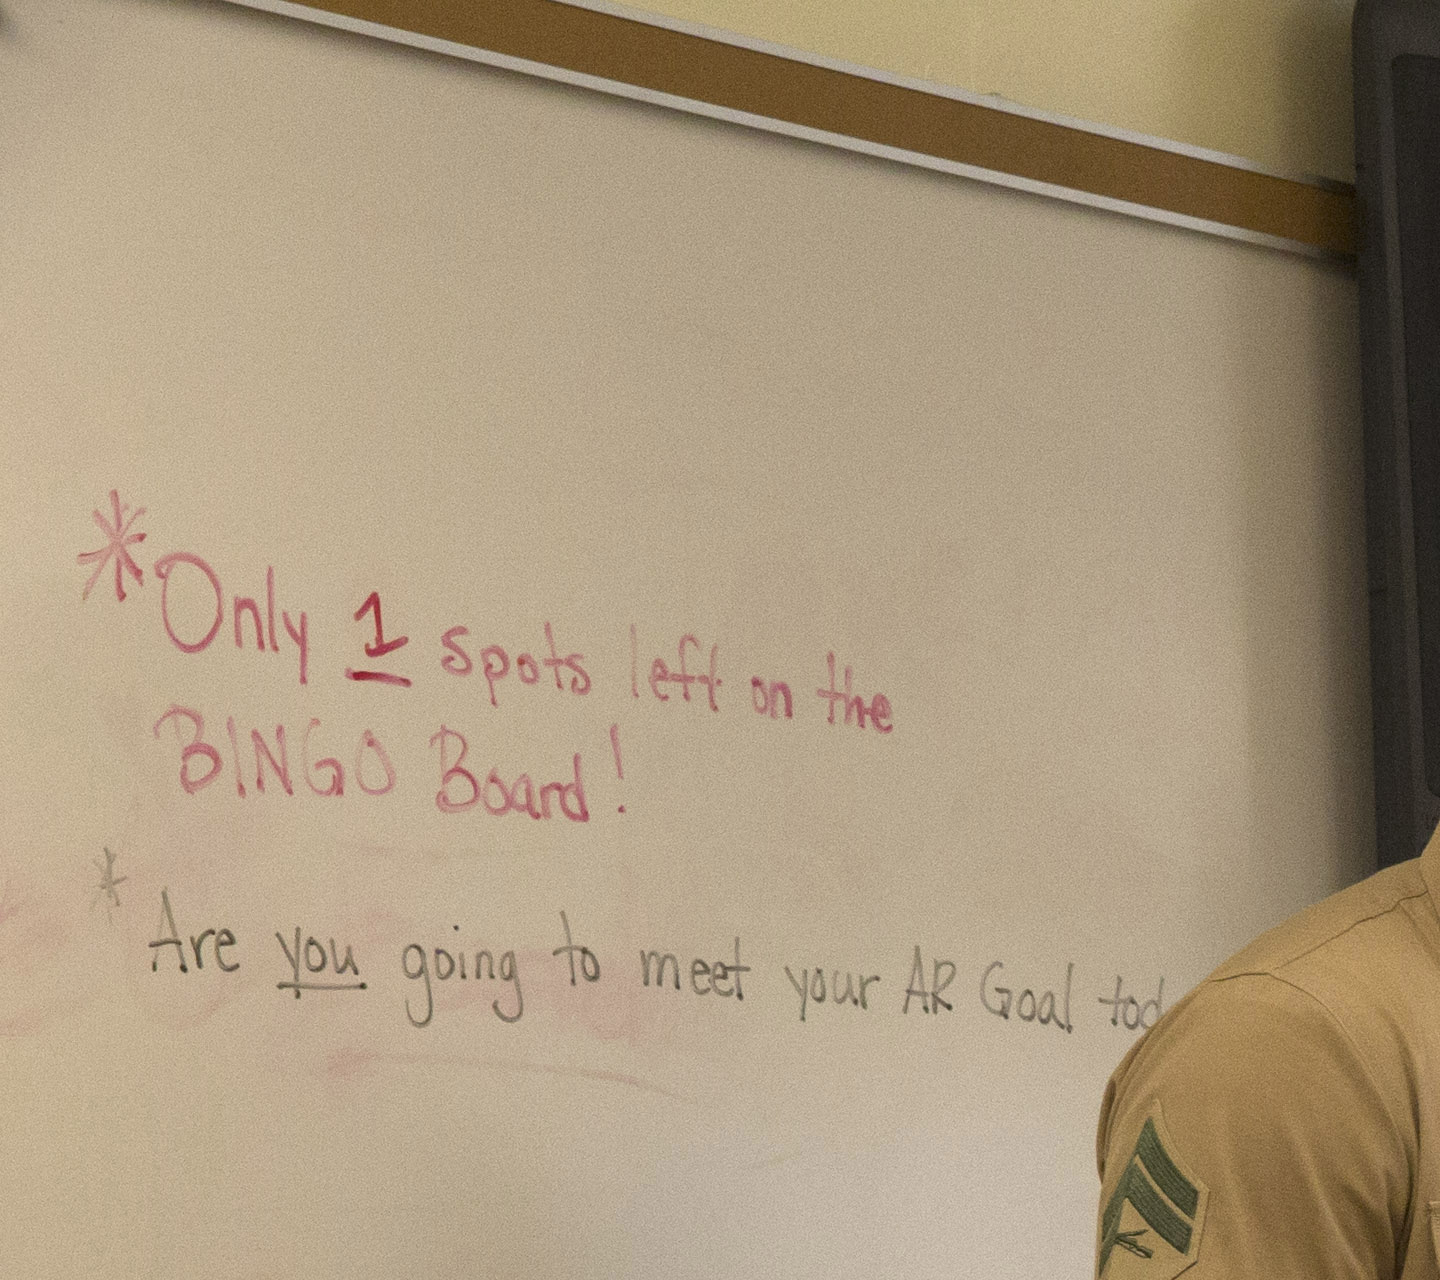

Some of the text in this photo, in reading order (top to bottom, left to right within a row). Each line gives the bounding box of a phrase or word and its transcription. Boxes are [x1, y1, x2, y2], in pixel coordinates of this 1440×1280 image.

[155, 551, 893, 734] Only 1 spots left on the
[153, 704, 626, 822] BINGO Board!
[148, 890, 1166, 1034] Are you going to meet your AR Goal tod
